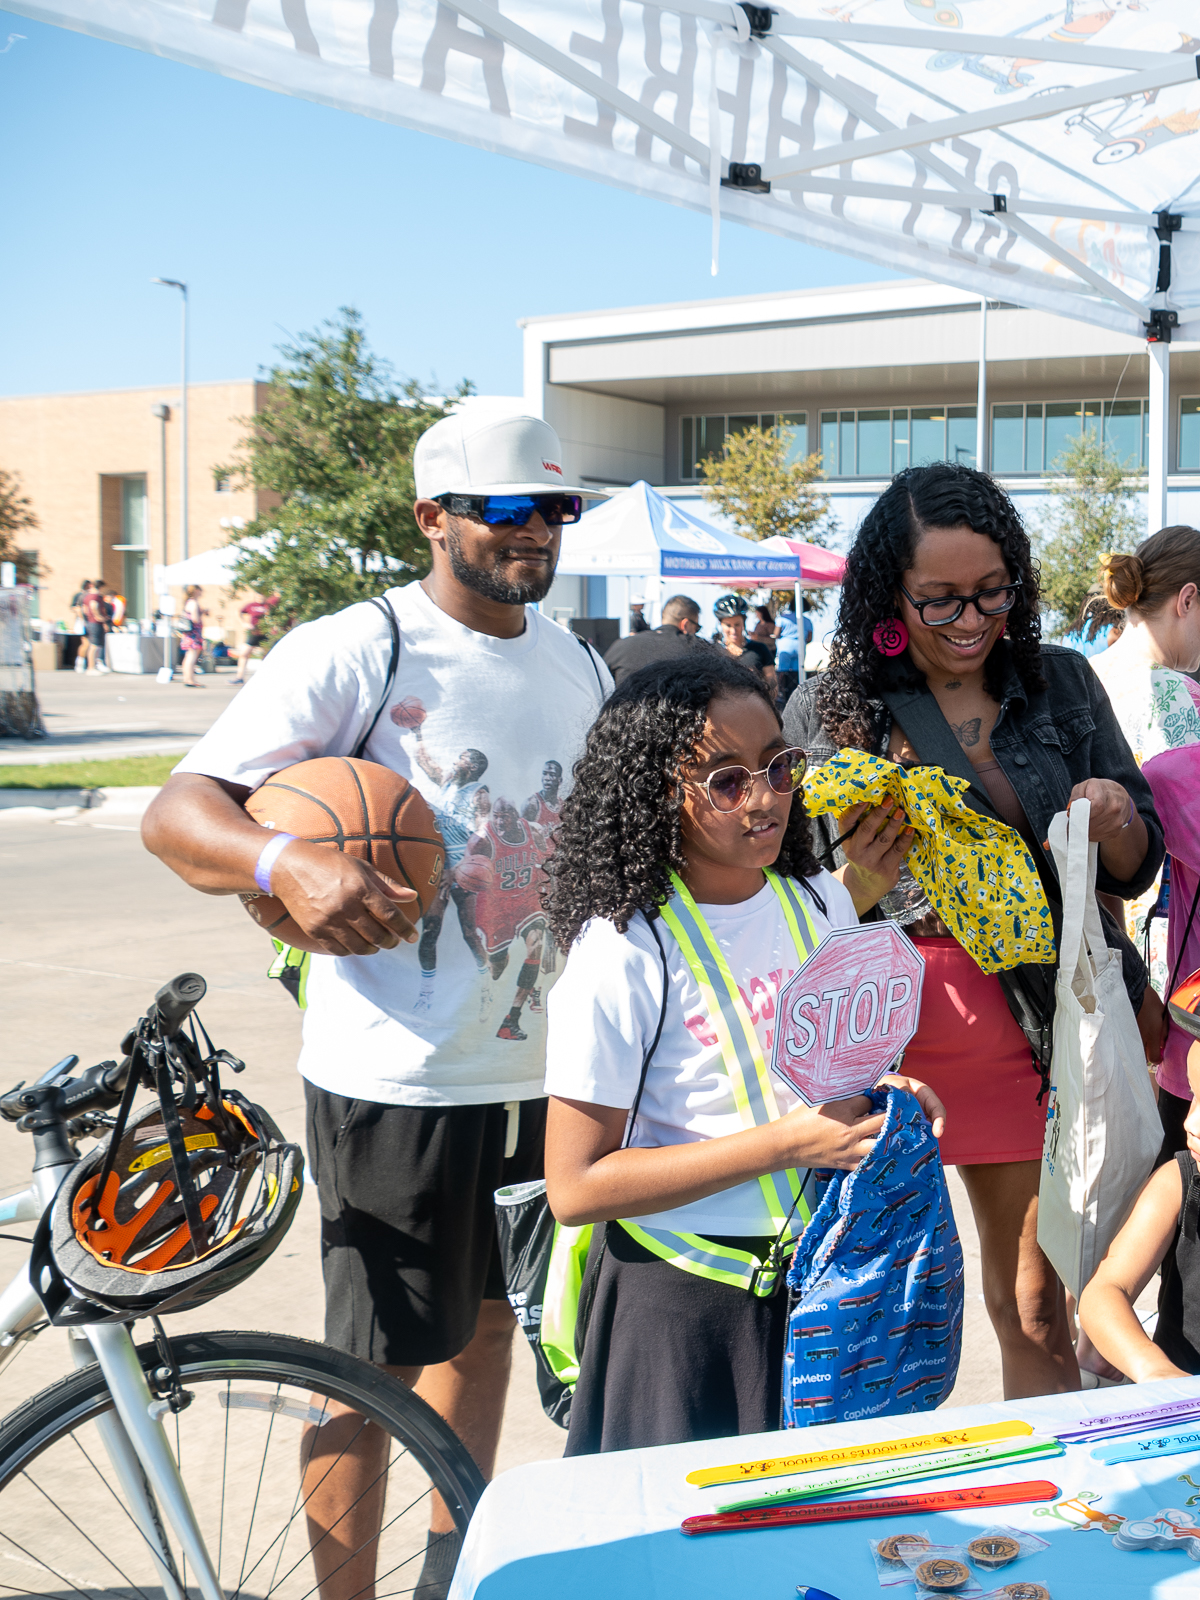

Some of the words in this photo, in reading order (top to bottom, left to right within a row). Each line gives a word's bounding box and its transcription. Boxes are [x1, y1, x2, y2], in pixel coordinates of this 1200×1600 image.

[709, 558, 732, 570] MILK
[732, 559, 756, 571] BANK
[495, 851, 537, 873] BULLS
[500, 866, 532, 891] 23
[785, 974, 912, 1057] STOP
[902, 1356, 946, 1373] CapMetro
[1113, 1409, 1159, 1422] SCHOOL
[1160, 1406, 1173, 1415] TO
[900, 1439, 932, 1450] SAFE
[831, 1452, 846, 1461] TO
[850, 1445, 898, 1457] ROUTES
[779, 1455, 829, 1468] SCHOOL
[857, 1500, 909, 1512] ROUTES
[911, 1495, 945, 1506] SAFE
[779, 1507, 836, 1518] SCHOOL
[837, 1506, 854, 1514] TO
